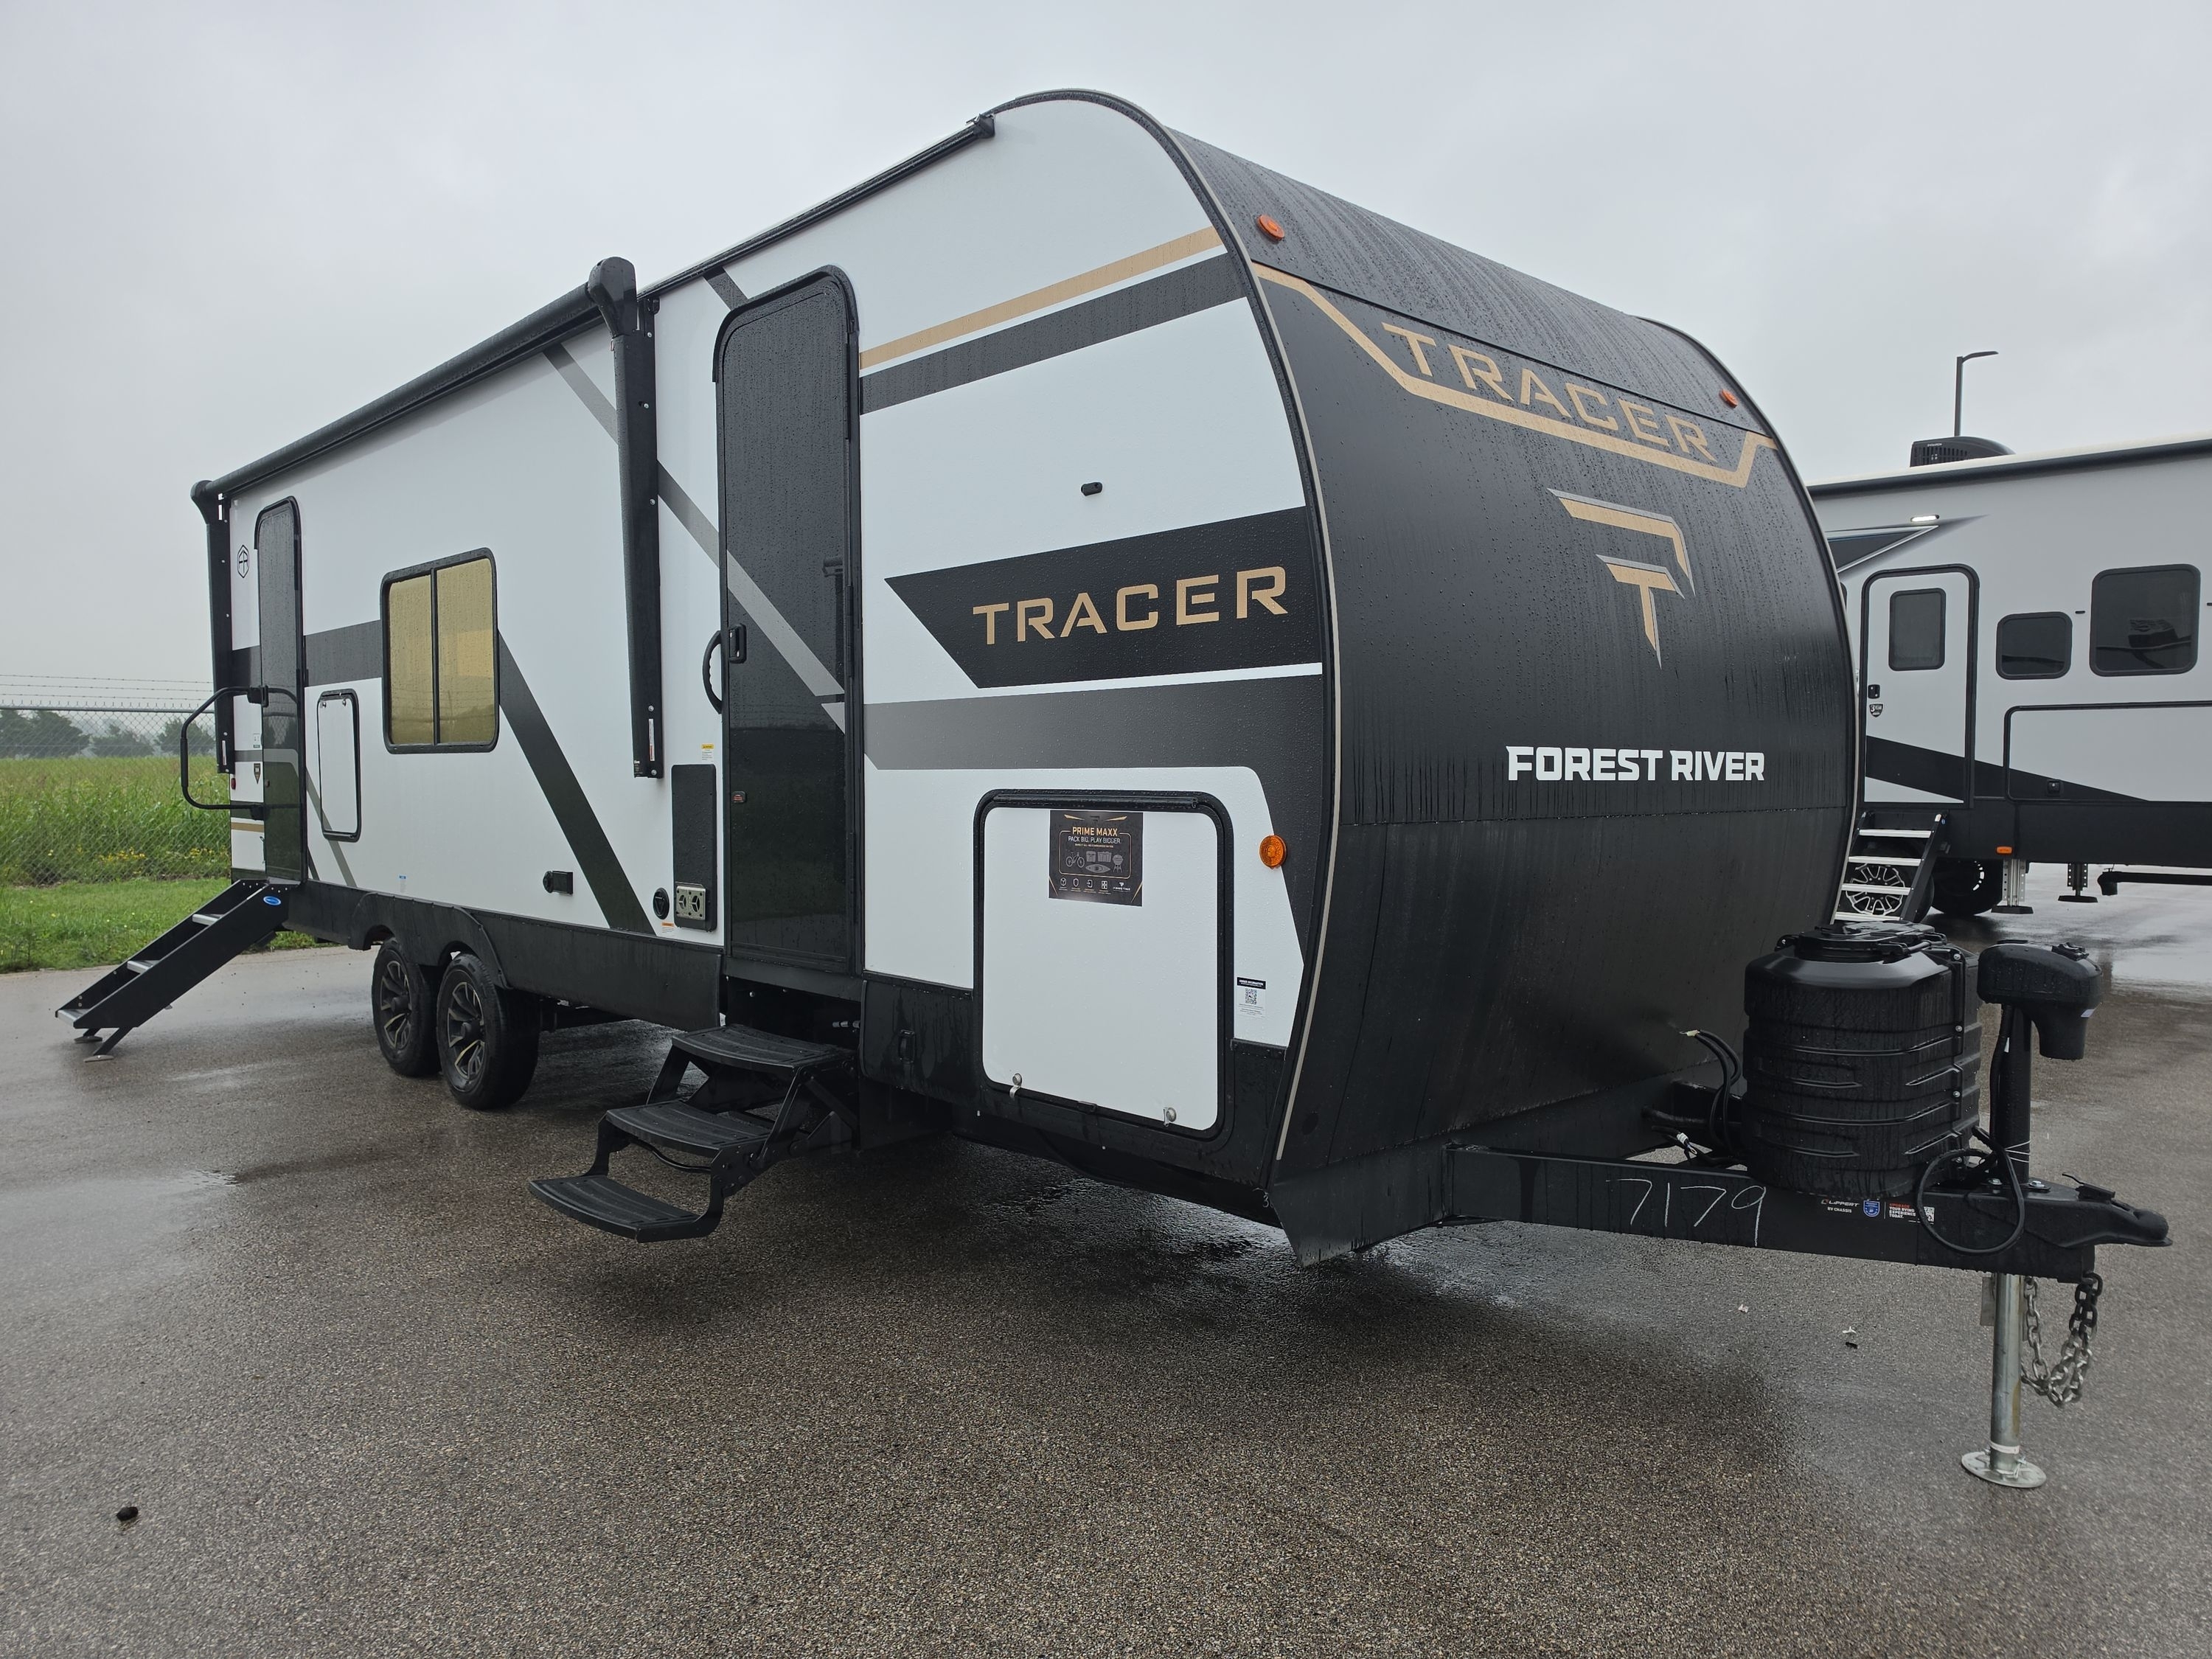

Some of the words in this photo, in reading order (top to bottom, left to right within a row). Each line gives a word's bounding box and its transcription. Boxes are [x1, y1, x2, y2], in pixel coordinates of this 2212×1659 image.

[1382, 322, 1718, 462] TRACER
[973, 566, 1289, 645] TRACER
[1506, 745, 1663, 781] FOREST
[1669, 750, 1765, 781] RIVER
[1072, 827, 1095, 835] PRIME
[1096, 827, 1118, 837] MAXX
[1606, 1178, 1767, 1246] 7179
